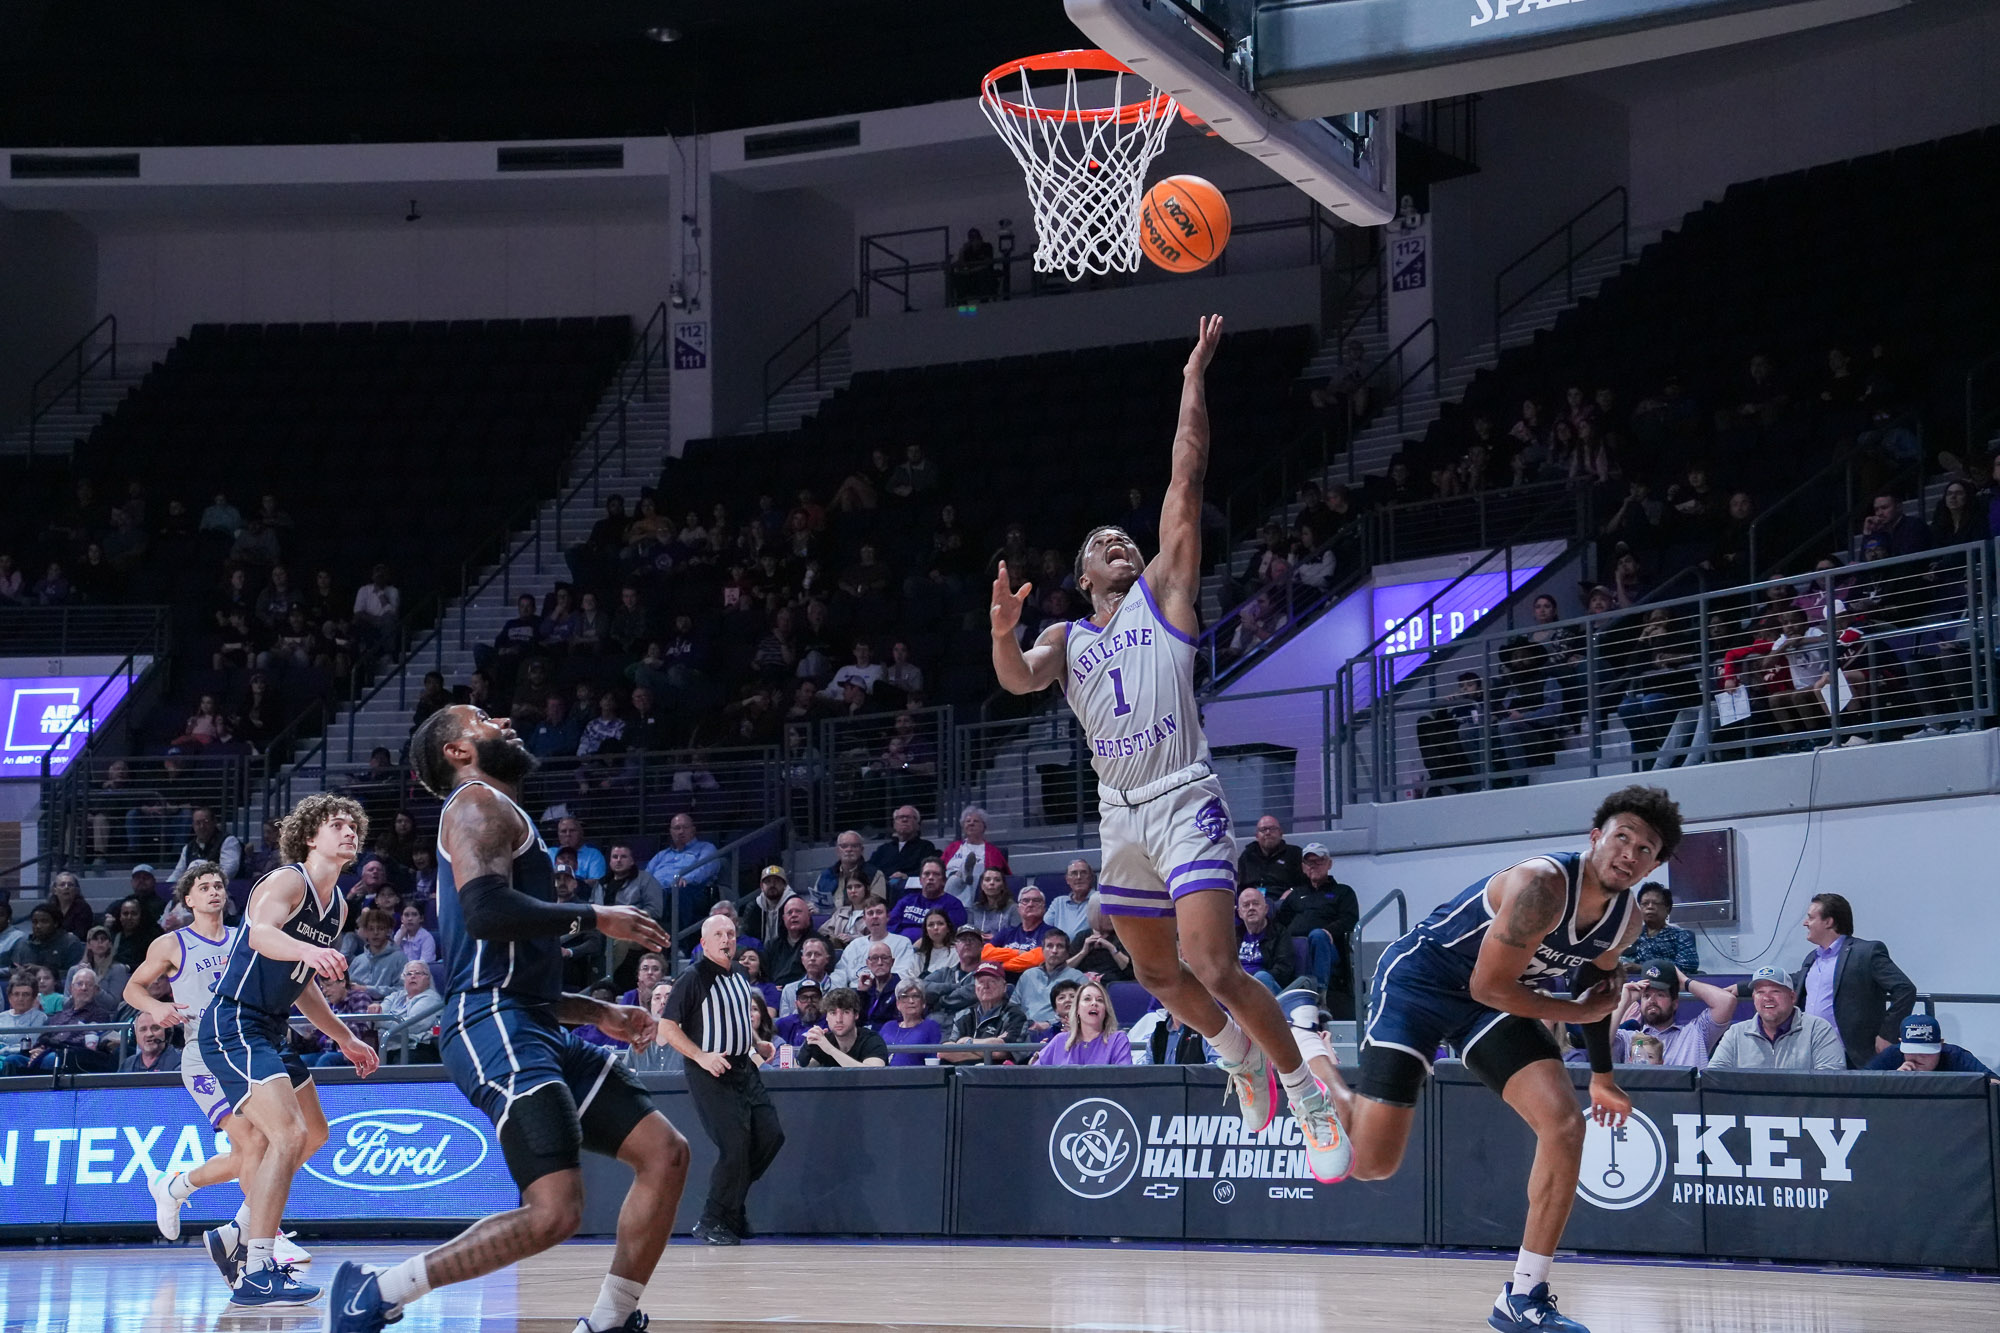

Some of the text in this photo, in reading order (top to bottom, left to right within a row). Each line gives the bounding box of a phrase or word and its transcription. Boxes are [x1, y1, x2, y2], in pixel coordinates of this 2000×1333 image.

[1163, 196, 1199, 239] NCAA
[1142, 204, 1181, 263] Wilson
[1396, 240, 1421, 256] 112
[1397, 272, 1421, 289] 113
[680, 325, 702, 338] 112
[680, 354, 701, 368] 111
[1072, 628, 1153, 685] ABILENE
[1107, 667, 1132, 718] 1
[41, 704, 80, 720] AEP
[40, 719, 95, 734] TEXAS
[1094, 713, 1178, 759] HRISTIAN
[3, 755, 69, 765] An AEP Cpany
[1536, 942, 1564, 962] TAH
[1147, 1115, 1310, 1146] LAWRENC
[332, 1120, 452, 1177] Ford
[1672, 1113, 1867, 1182] KEY
[1141, 1148, 1215, 1178] HALL
[1268, 1187, 1314, 1199] GMC
[1672, 1182, 1830, 1210] APPRAISAL GROUP
